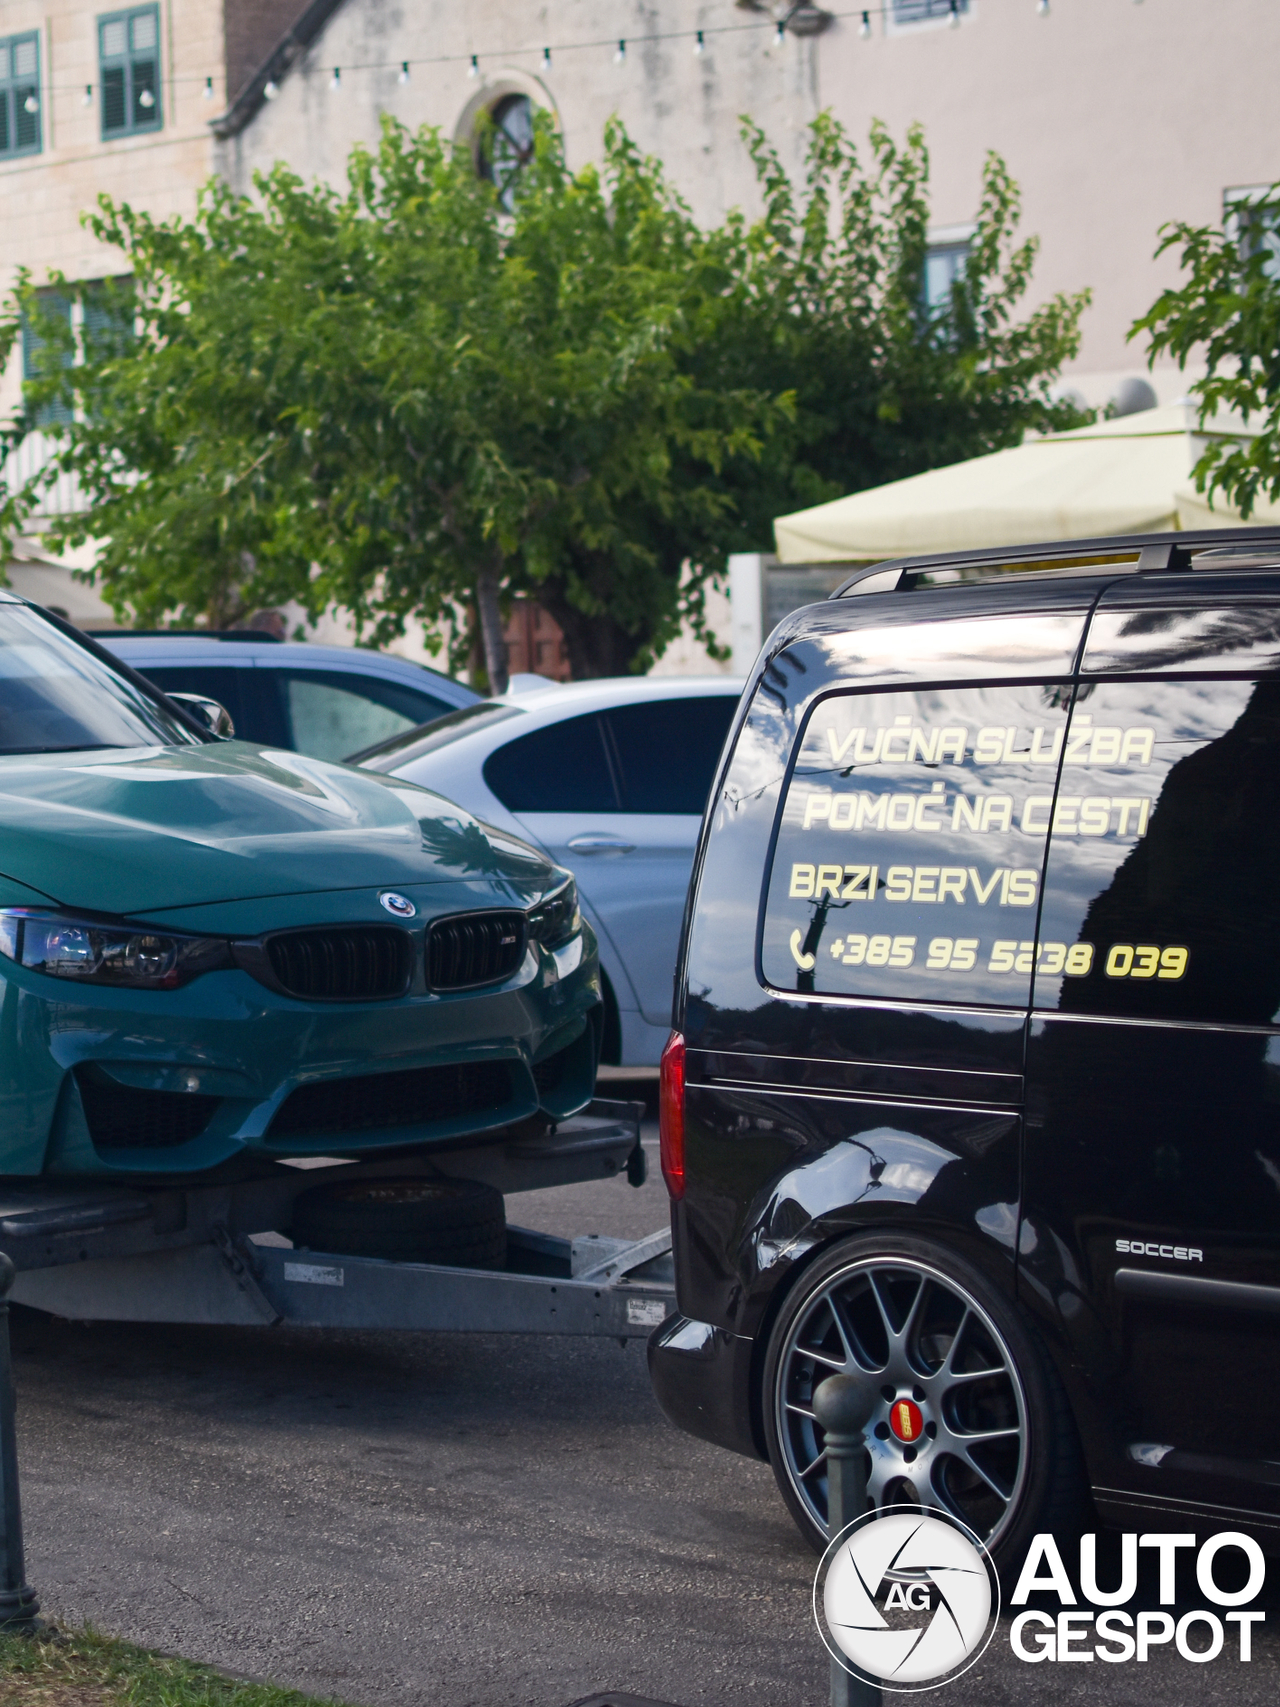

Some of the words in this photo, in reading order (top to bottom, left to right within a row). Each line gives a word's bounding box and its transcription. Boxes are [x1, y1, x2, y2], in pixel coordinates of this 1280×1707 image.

[826, 715, 968, 764] VUČNA
[973, 714, 1155, 765] SLUŽBA
[803, 782, 945, 831] POMOĆ
[950, 795, 1013, 833] NA
[1021, 795, 1152, 836] CESTI
[789, 863, 879, 900] BRZI
[884, 865, 1039, 906] SERVIS
[830, 934, 917, 968] +385
[925, 937, 979, 971] 95
[988, 940, 1094, 976] 5238
[1105, 944, 1189, 980] 039
[1115, 1239, 1203, 1262] SOCCER
[898, 1403, 913, 1438] BBS
